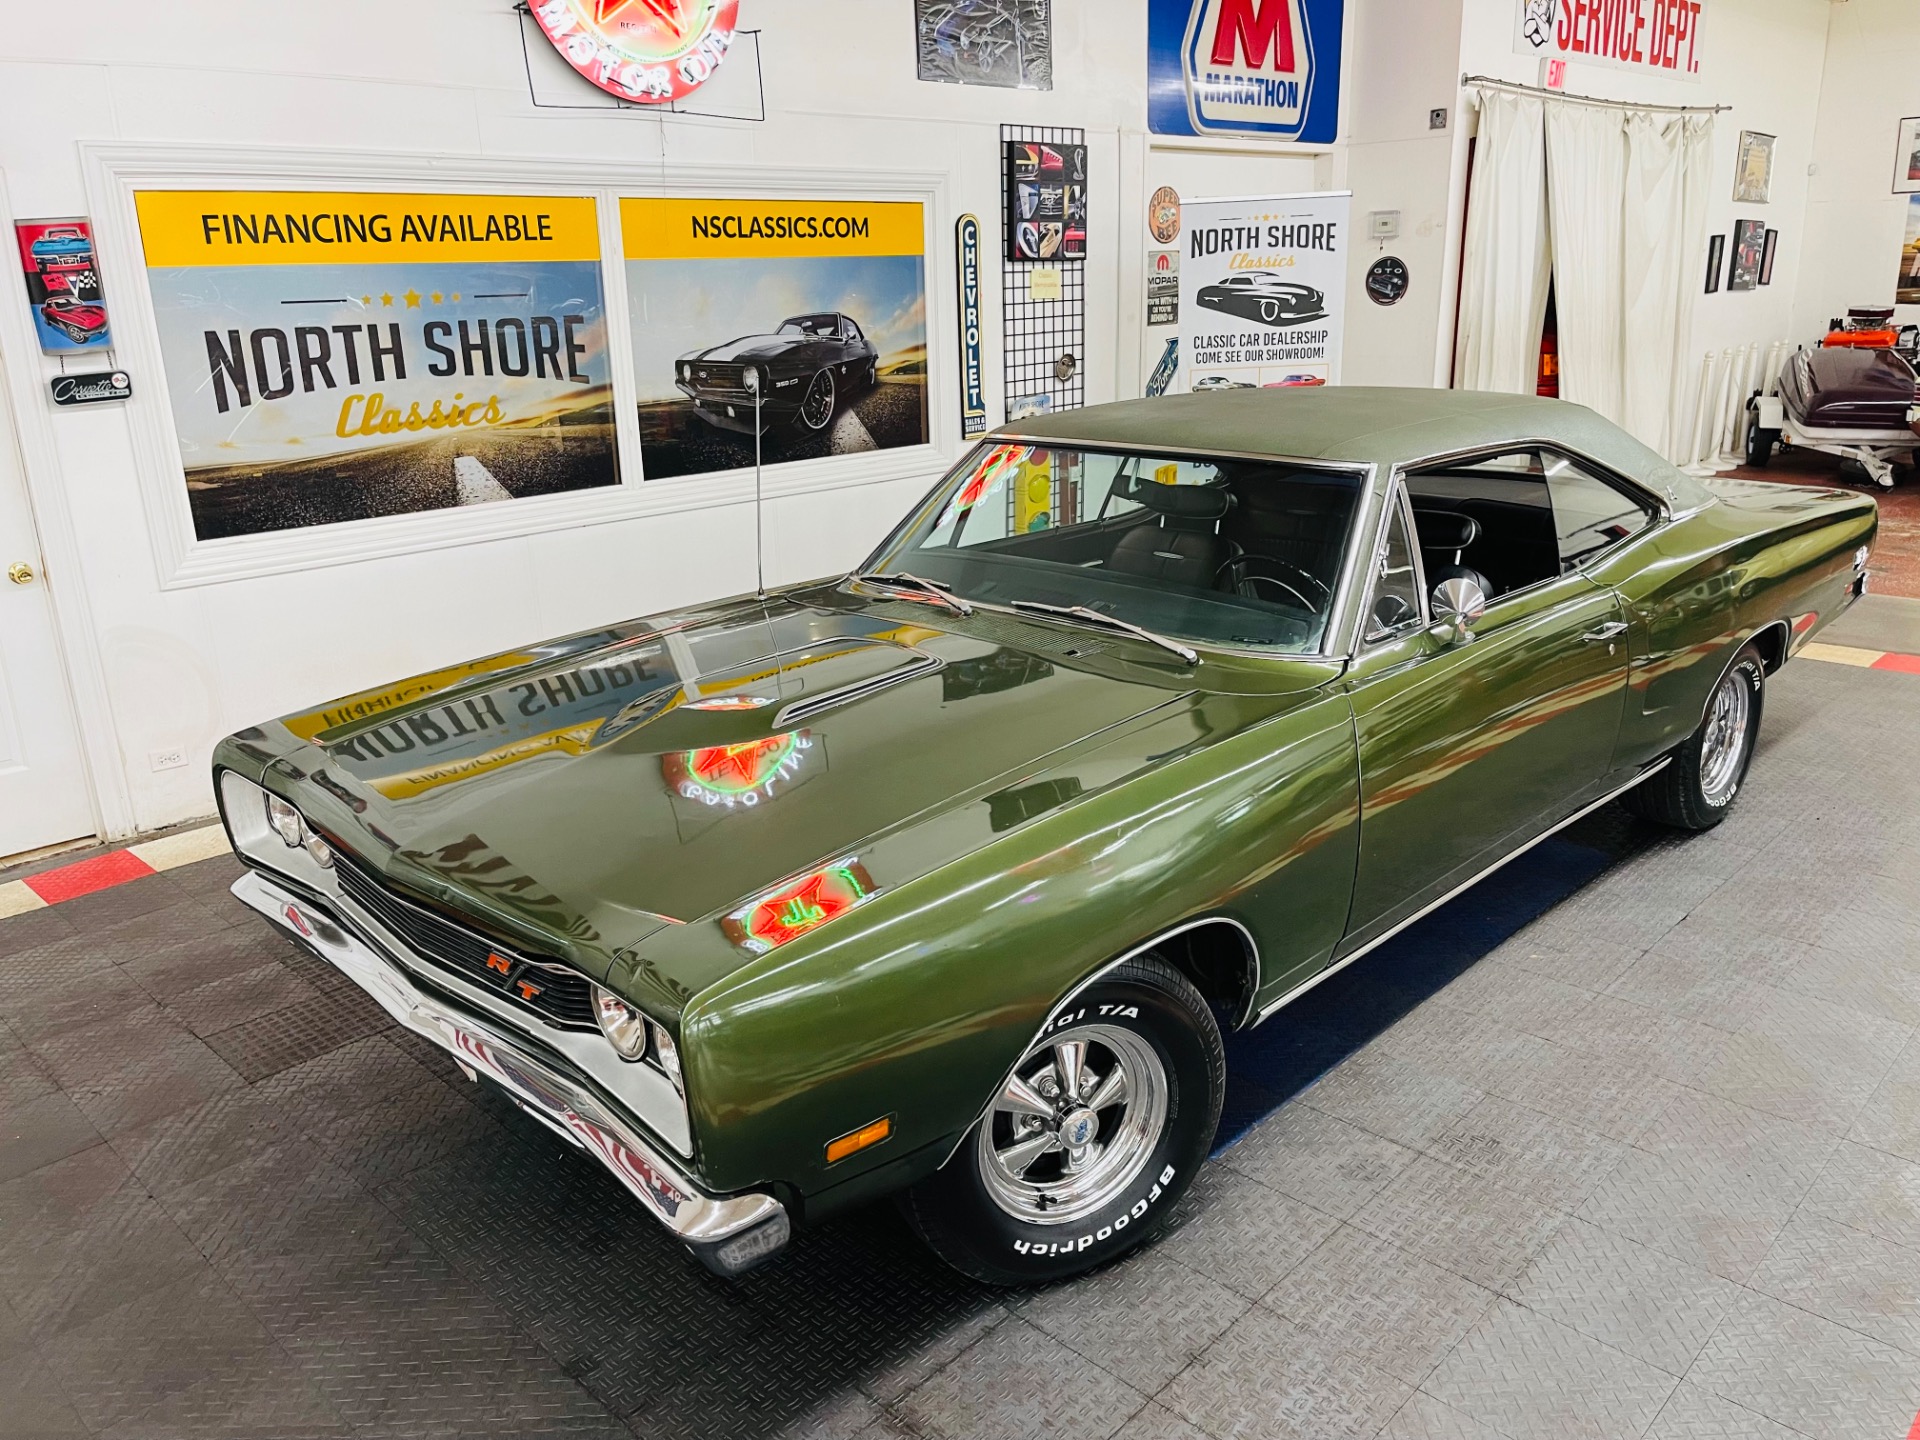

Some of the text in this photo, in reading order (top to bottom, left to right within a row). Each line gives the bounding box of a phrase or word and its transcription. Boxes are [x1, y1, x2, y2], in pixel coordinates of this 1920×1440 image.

[535, 0, 735, 99] MOTOR OIL
[1557, 0, 1701, 73] SERVICE DEPT.
[1547, 60, 1567, 89] EXIT
[1204, 73, 1299, 109] MARATHON
[1152, 189, 1180, 217] SUPER
[201, 213, 553, 245] FINANCING AVAILABLE
[691, 215, 869, 239] NSCLASSICS.COM
[1157, 220, 1178, 240] BEE
[1191, 223, 1337, 259] NORTH SHORE
[1229, 253, 1296, 270] Classics
[1148, 276, 1178, 285] MOPAR
[963, 225, 980, 406] CHEVROLET
[1193, 330, 1329, 349] CLASSIC CAR DEALERSHIP
[1195, 347, 1325, 364] COME SEE OUR SHOWROOM!
[204, 314, 591, 414] NORTH SHORE
[1153, 357, 1174, 397] Ford
[54, 378, 115, 401] Corvette
[335, 391, 507, 439] Classics
[486, 951, 546, 1000] R/T
[1099, 1004, 1139, 1019] T/A
[1013, 1163, 1176, 1257] BFGoodrich
